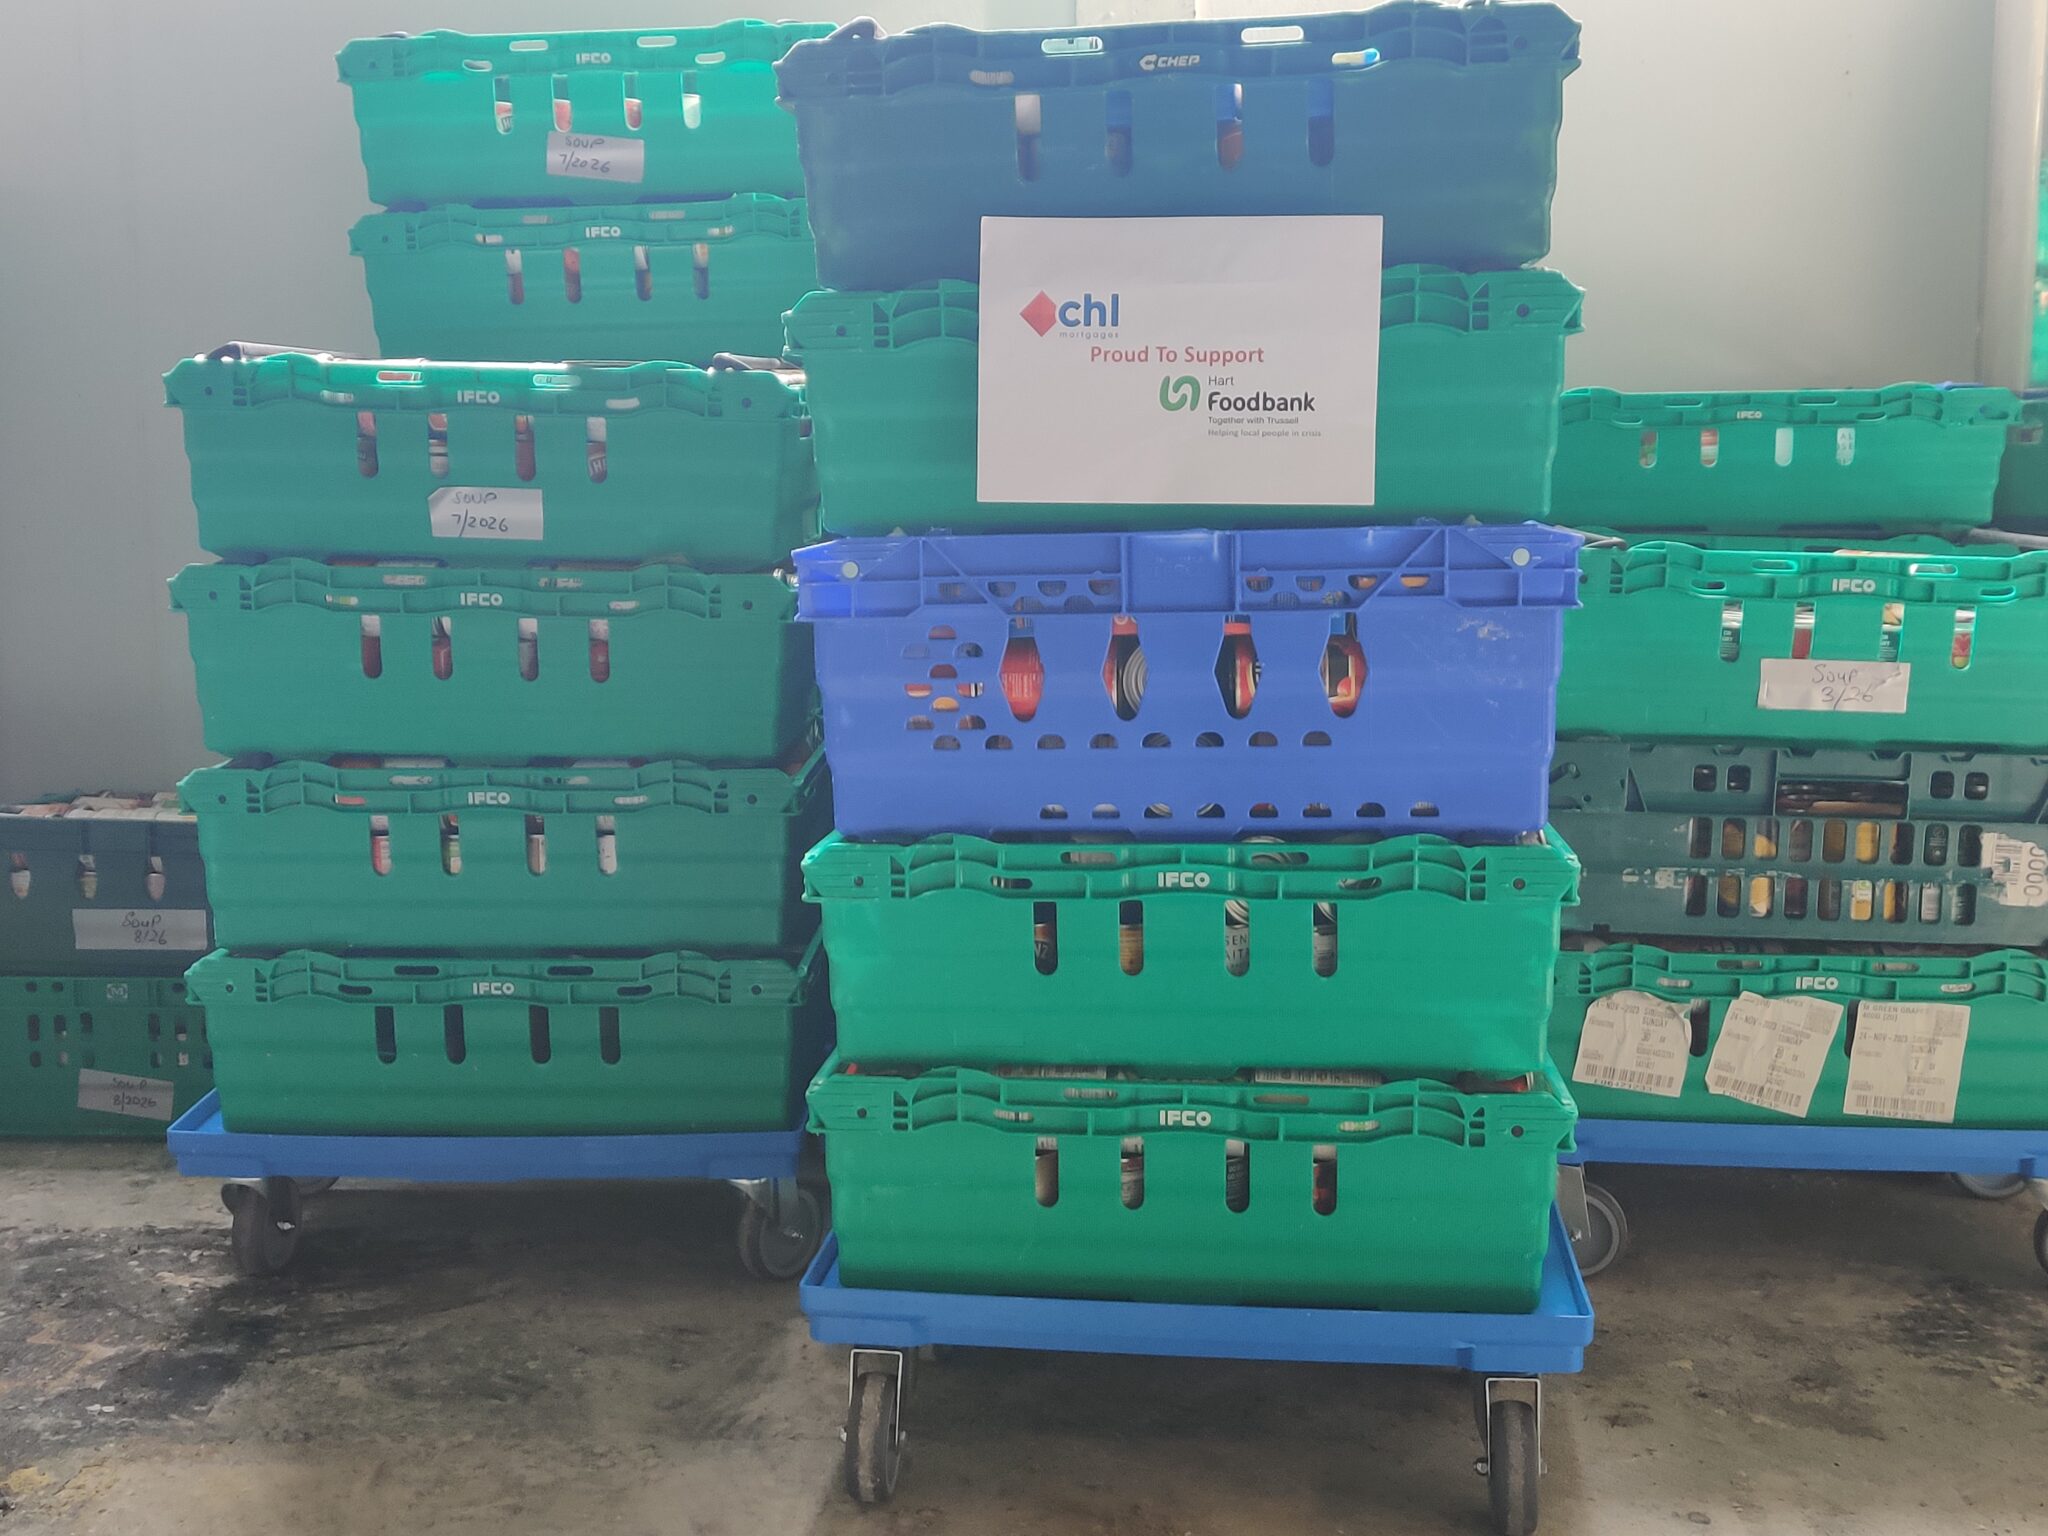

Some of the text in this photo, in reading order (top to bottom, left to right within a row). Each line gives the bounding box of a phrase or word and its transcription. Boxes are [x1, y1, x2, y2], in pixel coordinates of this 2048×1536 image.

[576, 53, 611, 64] IFCO
[1158, 55, 1200, 67] CHEP
[565, 136, 605, 148] SOUP
[559, 151, 610, 173] 7/2026
[586, 227, 621, 238] IFCO
[1058, 293, 1119, 327] chl
[1059, 331, 1118, 339] mortgages
[1091, 345, 1264, 366] Proud To Support
[1208, 376, 1234, 386] Hart
[457, 391, 500, 404] IFCO
[1208, 391, 1315, 411] Foodbank
[1208, 416, 1298, 425] Together with Trussell
[1208, 429, 1321, 438] Helping local people in crisis
[453, 491, 497, 504] SOUP
[451, 508, 508, 536] 7/2026
[1832, 578, 1876, 593] IFCO
[460, 592, 502, 606] IFCO
[1821, 685, 1873, 709] 3/26
[468, 792, 510, 805] IFCO
[1158, 872, 1210, 887] IFCO
[134, 930, 167, 945] 8/26
[473, 982, 515, 995] IFCO
[1796, 977, 1839, 990] IFCO
[1159, 1110, 1211, 1127] IFCO
